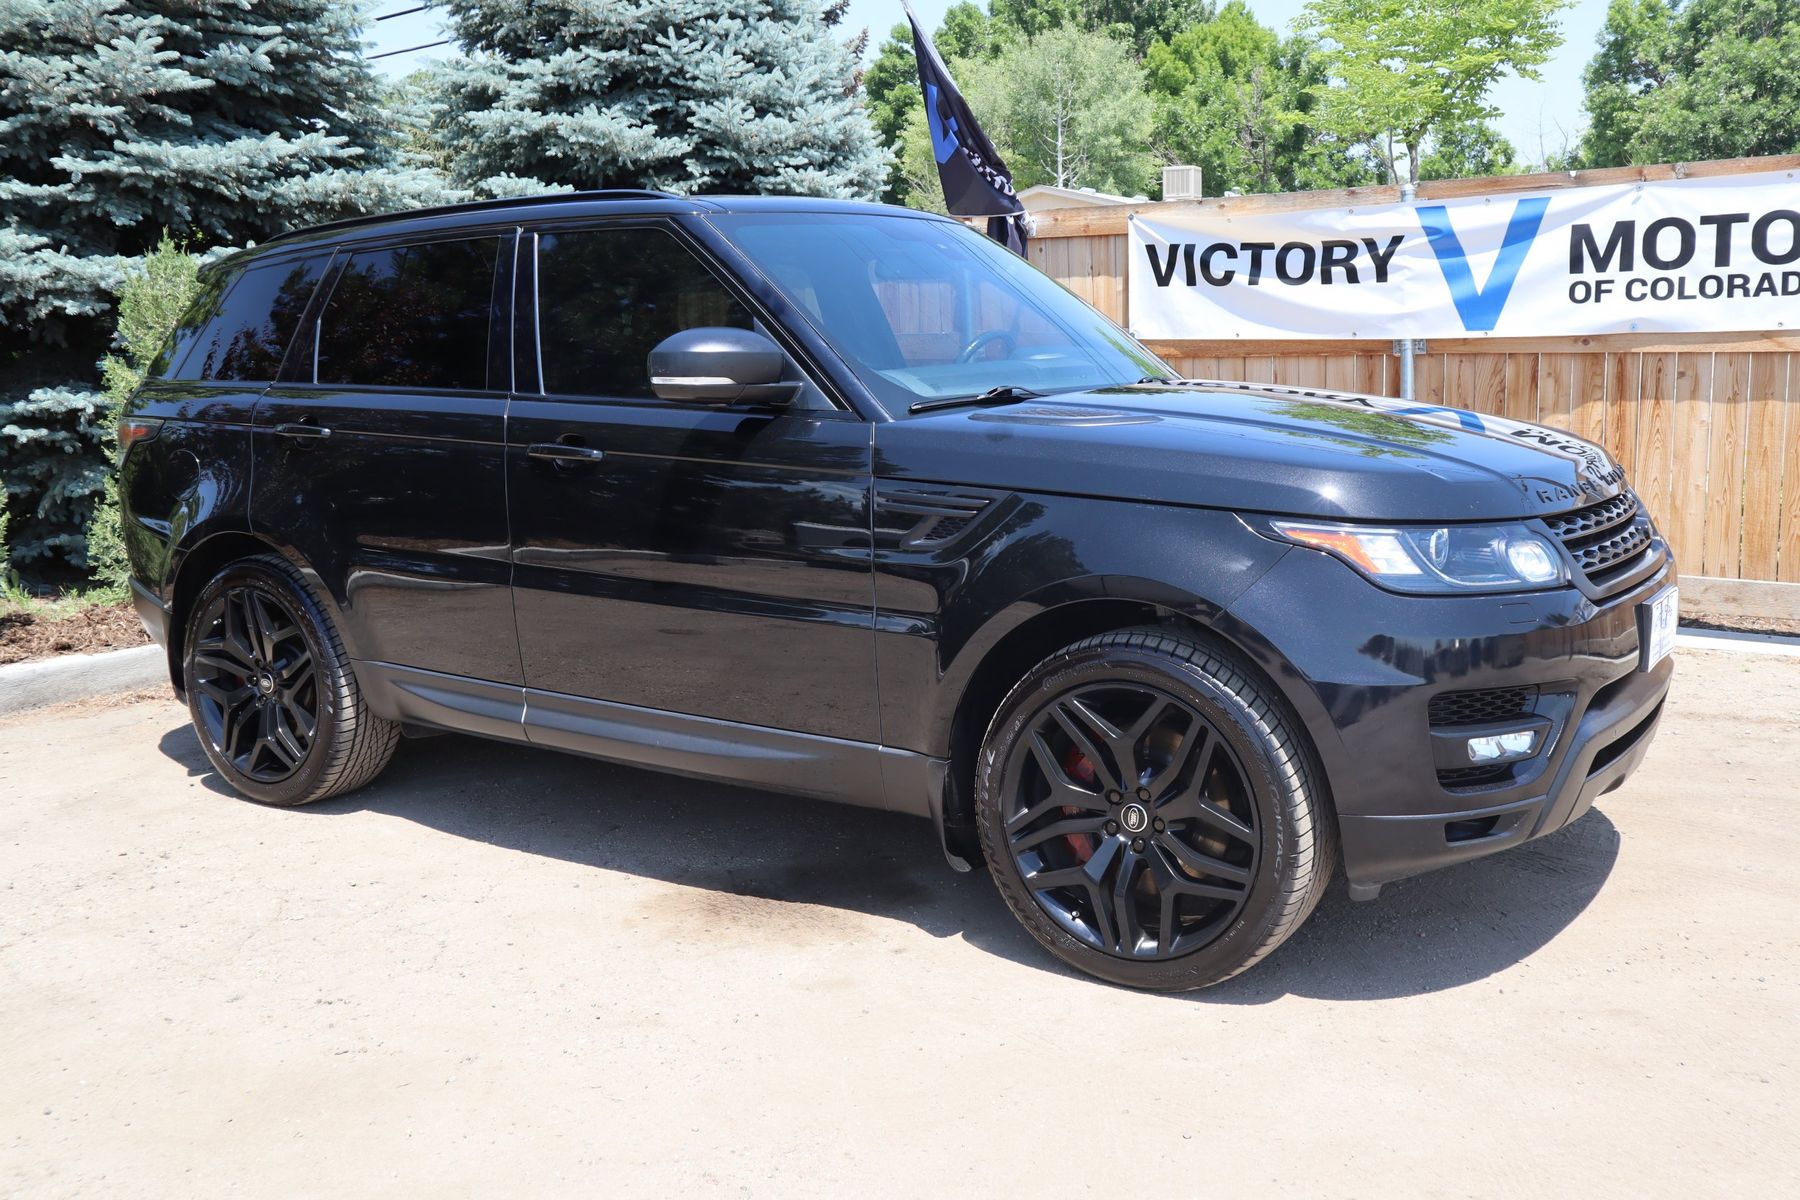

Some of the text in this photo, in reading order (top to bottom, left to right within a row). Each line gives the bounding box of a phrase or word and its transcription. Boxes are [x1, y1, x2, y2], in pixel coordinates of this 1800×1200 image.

[1145, 235, 1405, 287] VICTORY
[1415, 197, 1551, 332] V
[1569, 280, 1615, 304] OF
